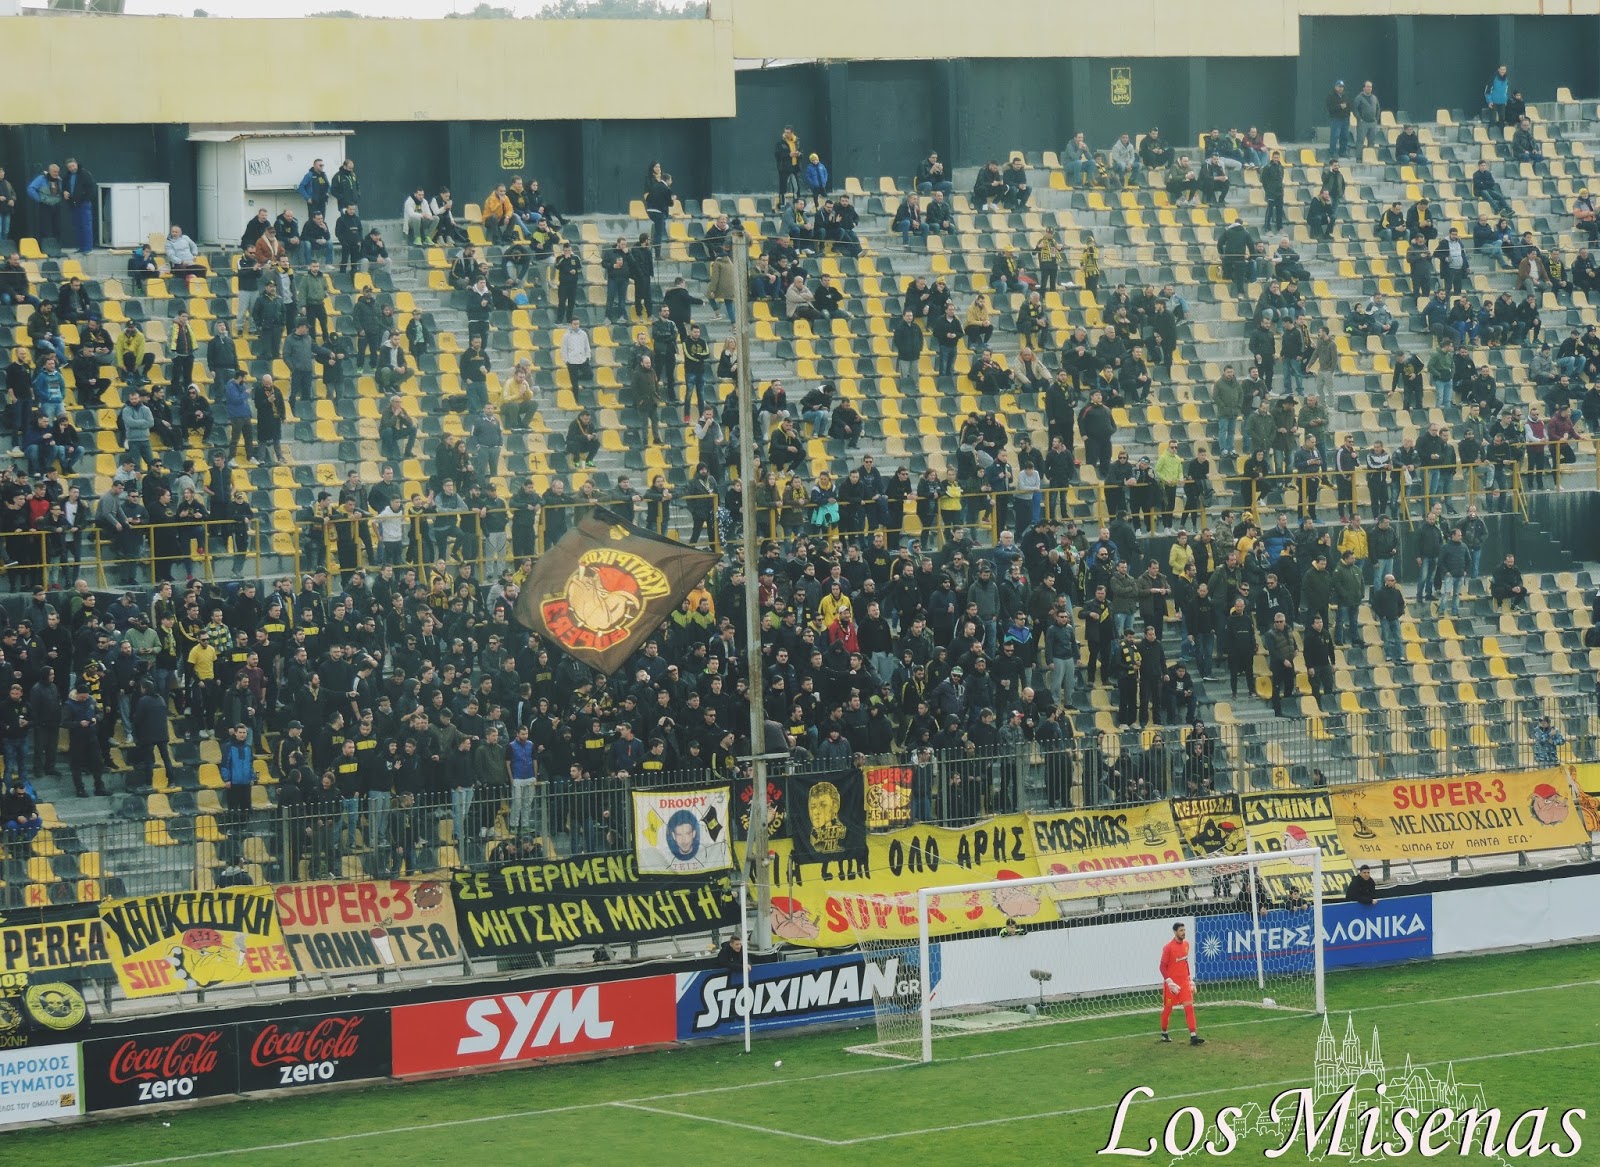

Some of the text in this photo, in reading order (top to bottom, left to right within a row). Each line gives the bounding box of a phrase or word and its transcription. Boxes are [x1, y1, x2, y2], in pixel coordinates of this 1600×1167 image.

[659, 796, 707, 809] DROOPY
[1393, 779, 1507, 810] SUPER-3
[958, 826, 1026, 869] ΑΡΗΣ
[1033, 814, 1130, 853] EVOSMOS
[1359, 844, 1382, 853] 1914
[455, 872, 493, 900] ΣΕ
[467, 899, 604, 948] ΜΗΤΣΑΡΑ
[3, 921, 109, 970] PEREA
[250, 1016, 364, 1067] Coca-Cola
[457, 986, 614, 1059] SYM
[109, 1031, 223, 1084] Coca-Cola
